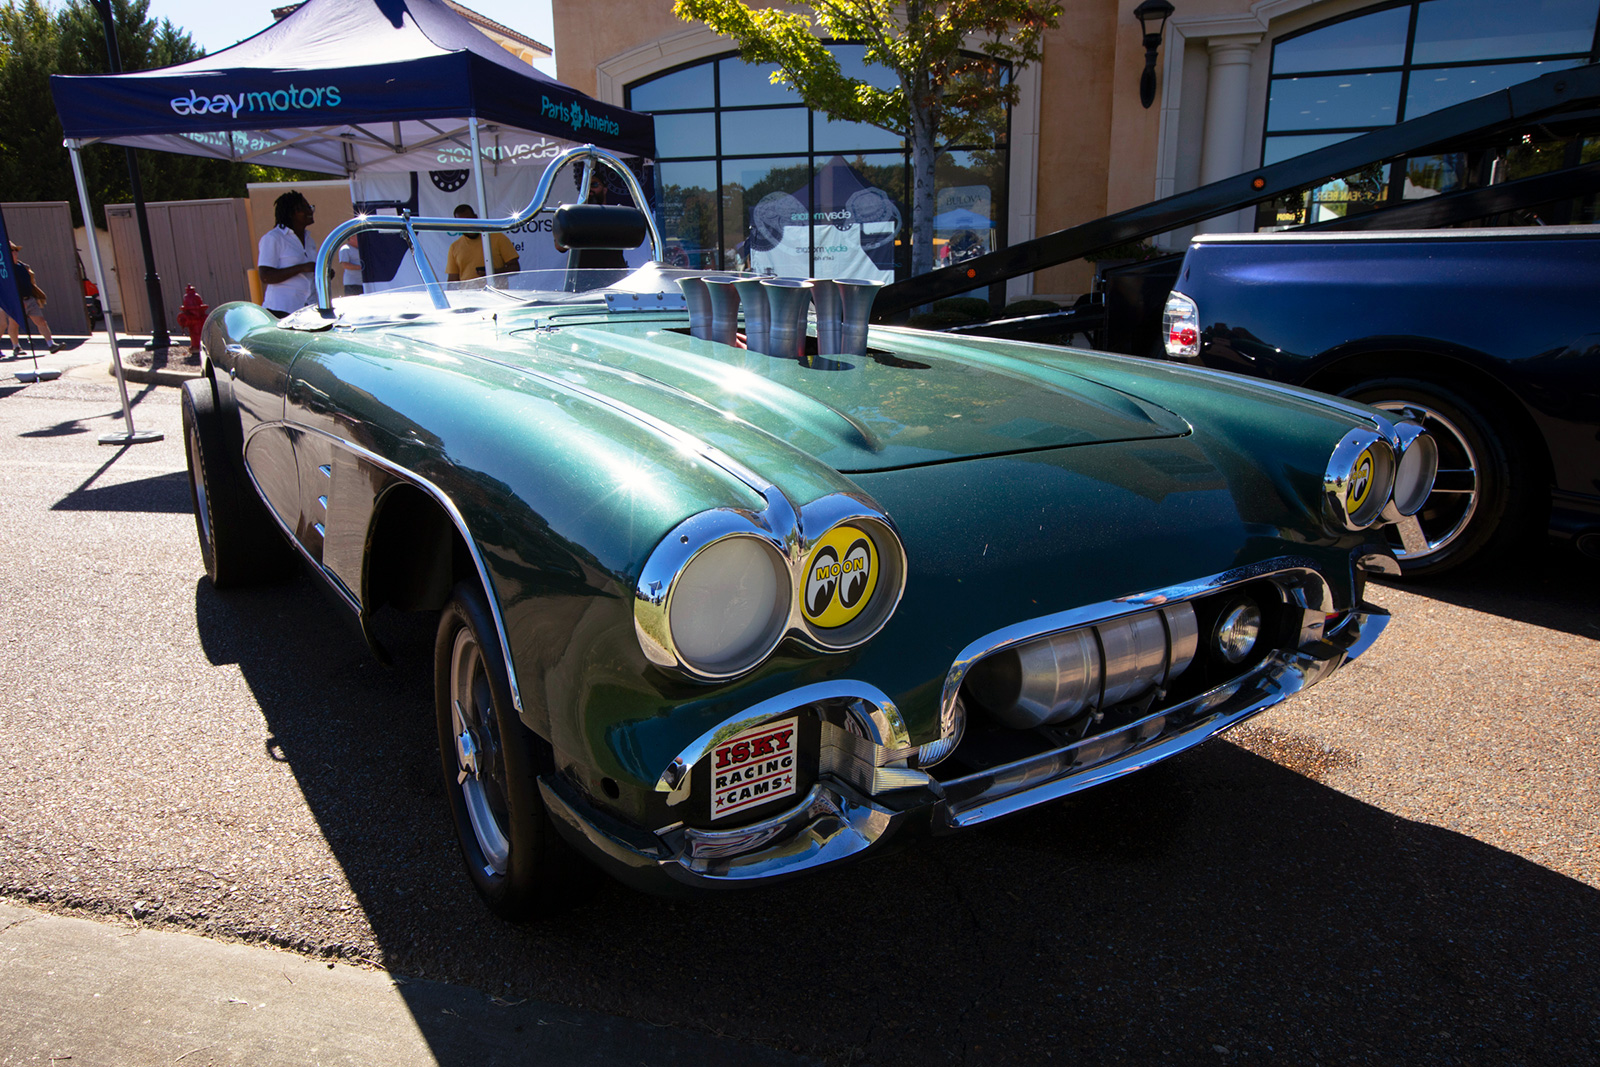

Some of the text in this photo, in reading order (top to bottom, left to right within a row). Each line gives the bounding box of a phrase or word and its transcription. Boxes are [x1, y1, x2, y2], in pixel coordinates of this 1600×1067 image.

[541, 95, 570, 122] Parts
[584, 109, 620, 136] America
[816, 557, 864, 581] MOON
[715, 729, 793, 769] ISKY
[716, 756, 793, 789] RACING
[727, 777, 782, 803] CAMS
